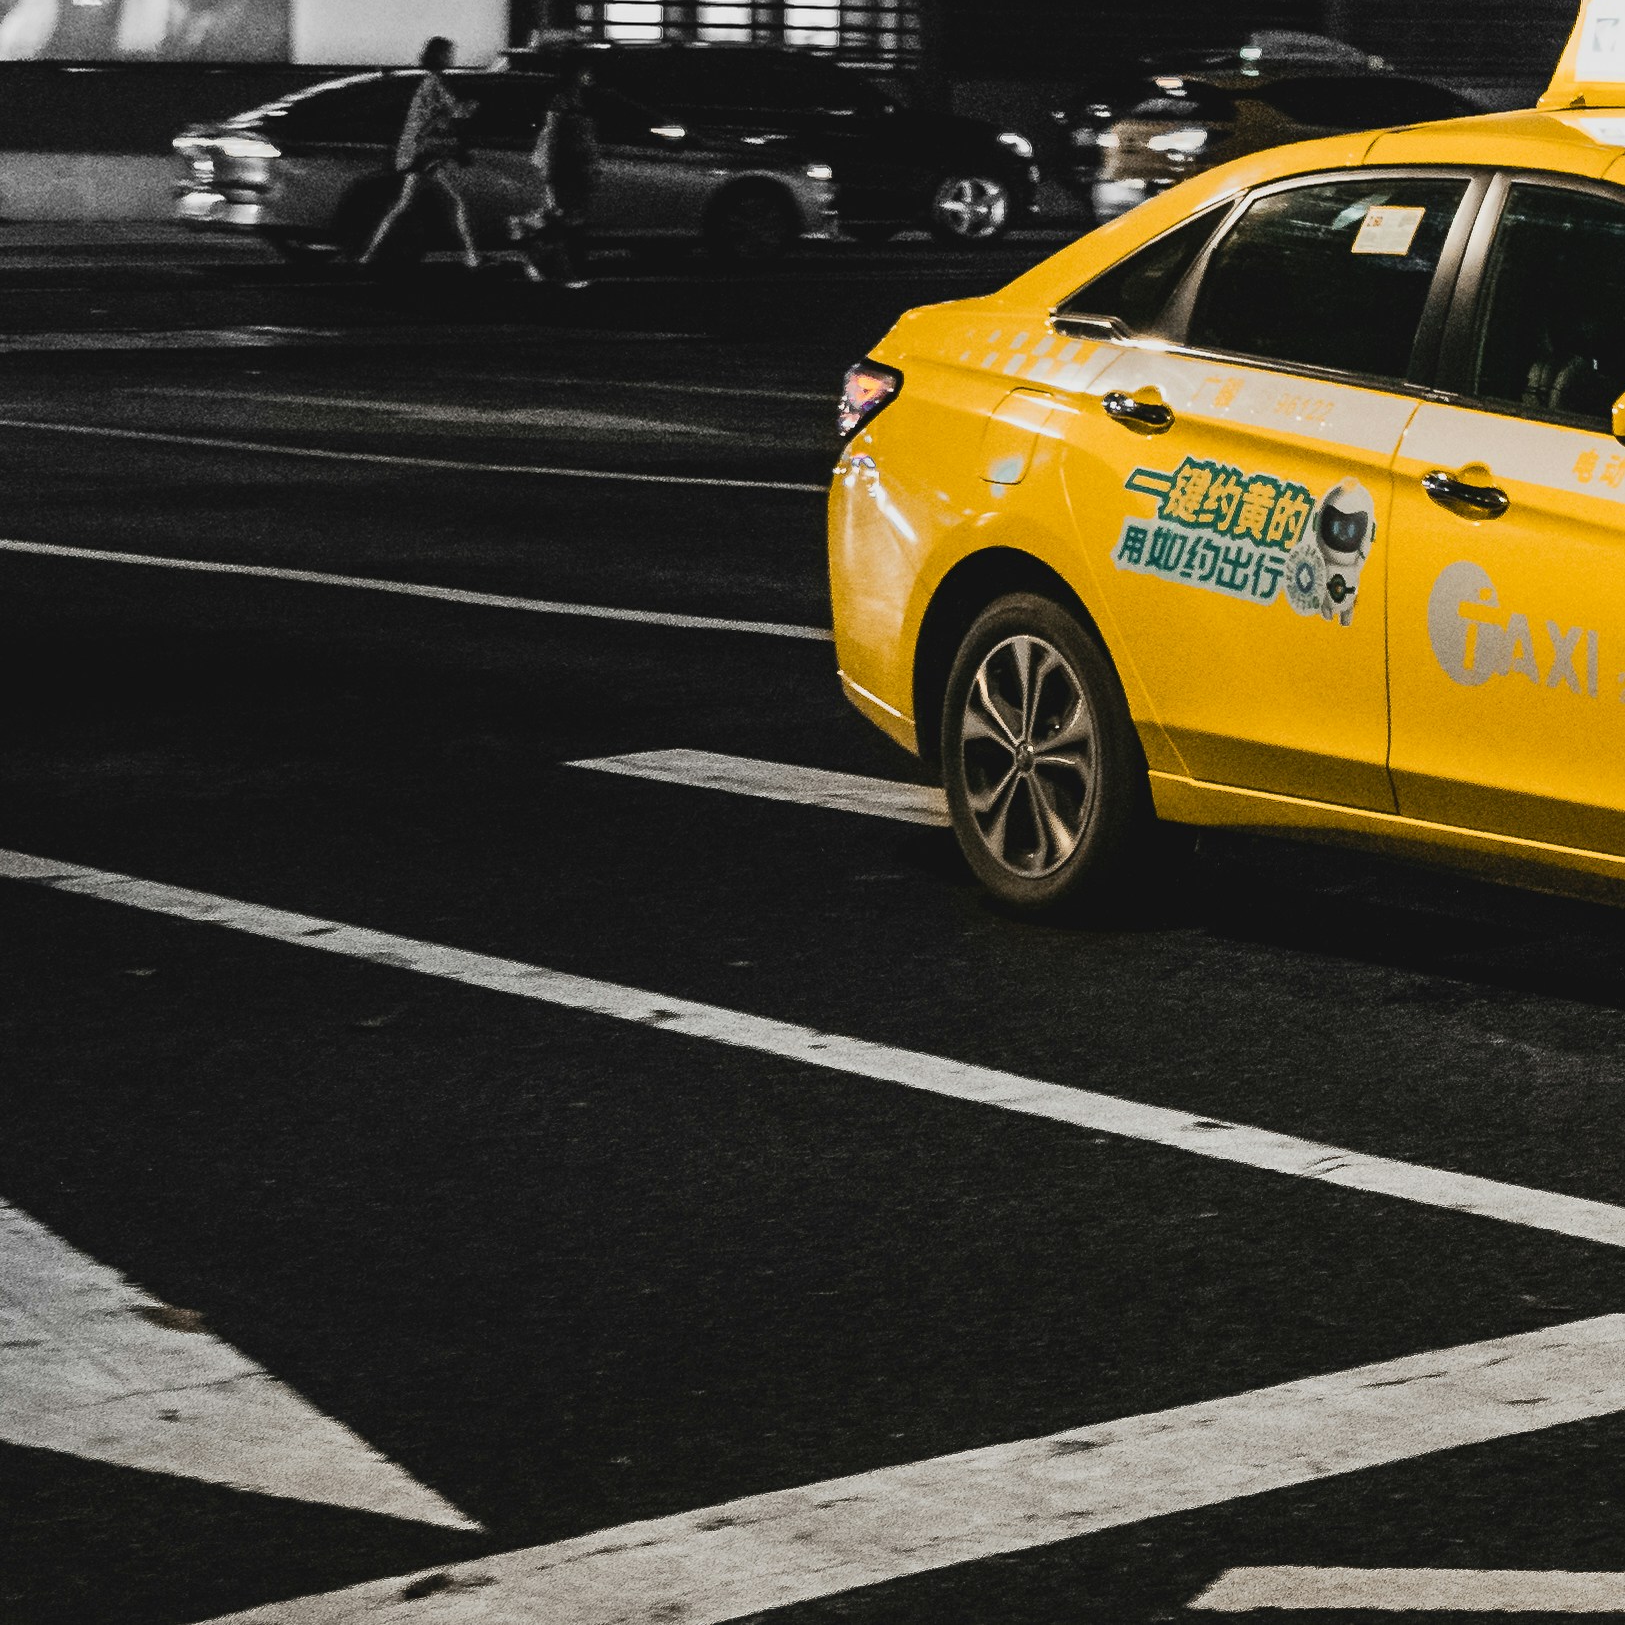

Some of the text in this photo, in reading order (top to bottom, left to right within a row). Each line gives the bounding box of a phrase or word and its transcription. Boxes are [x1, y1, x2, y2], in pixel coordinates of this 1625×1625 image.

[1126, 458, 1314, 551] 一键约黄的
[1117, 524, 1286, 600] 用如约出行
